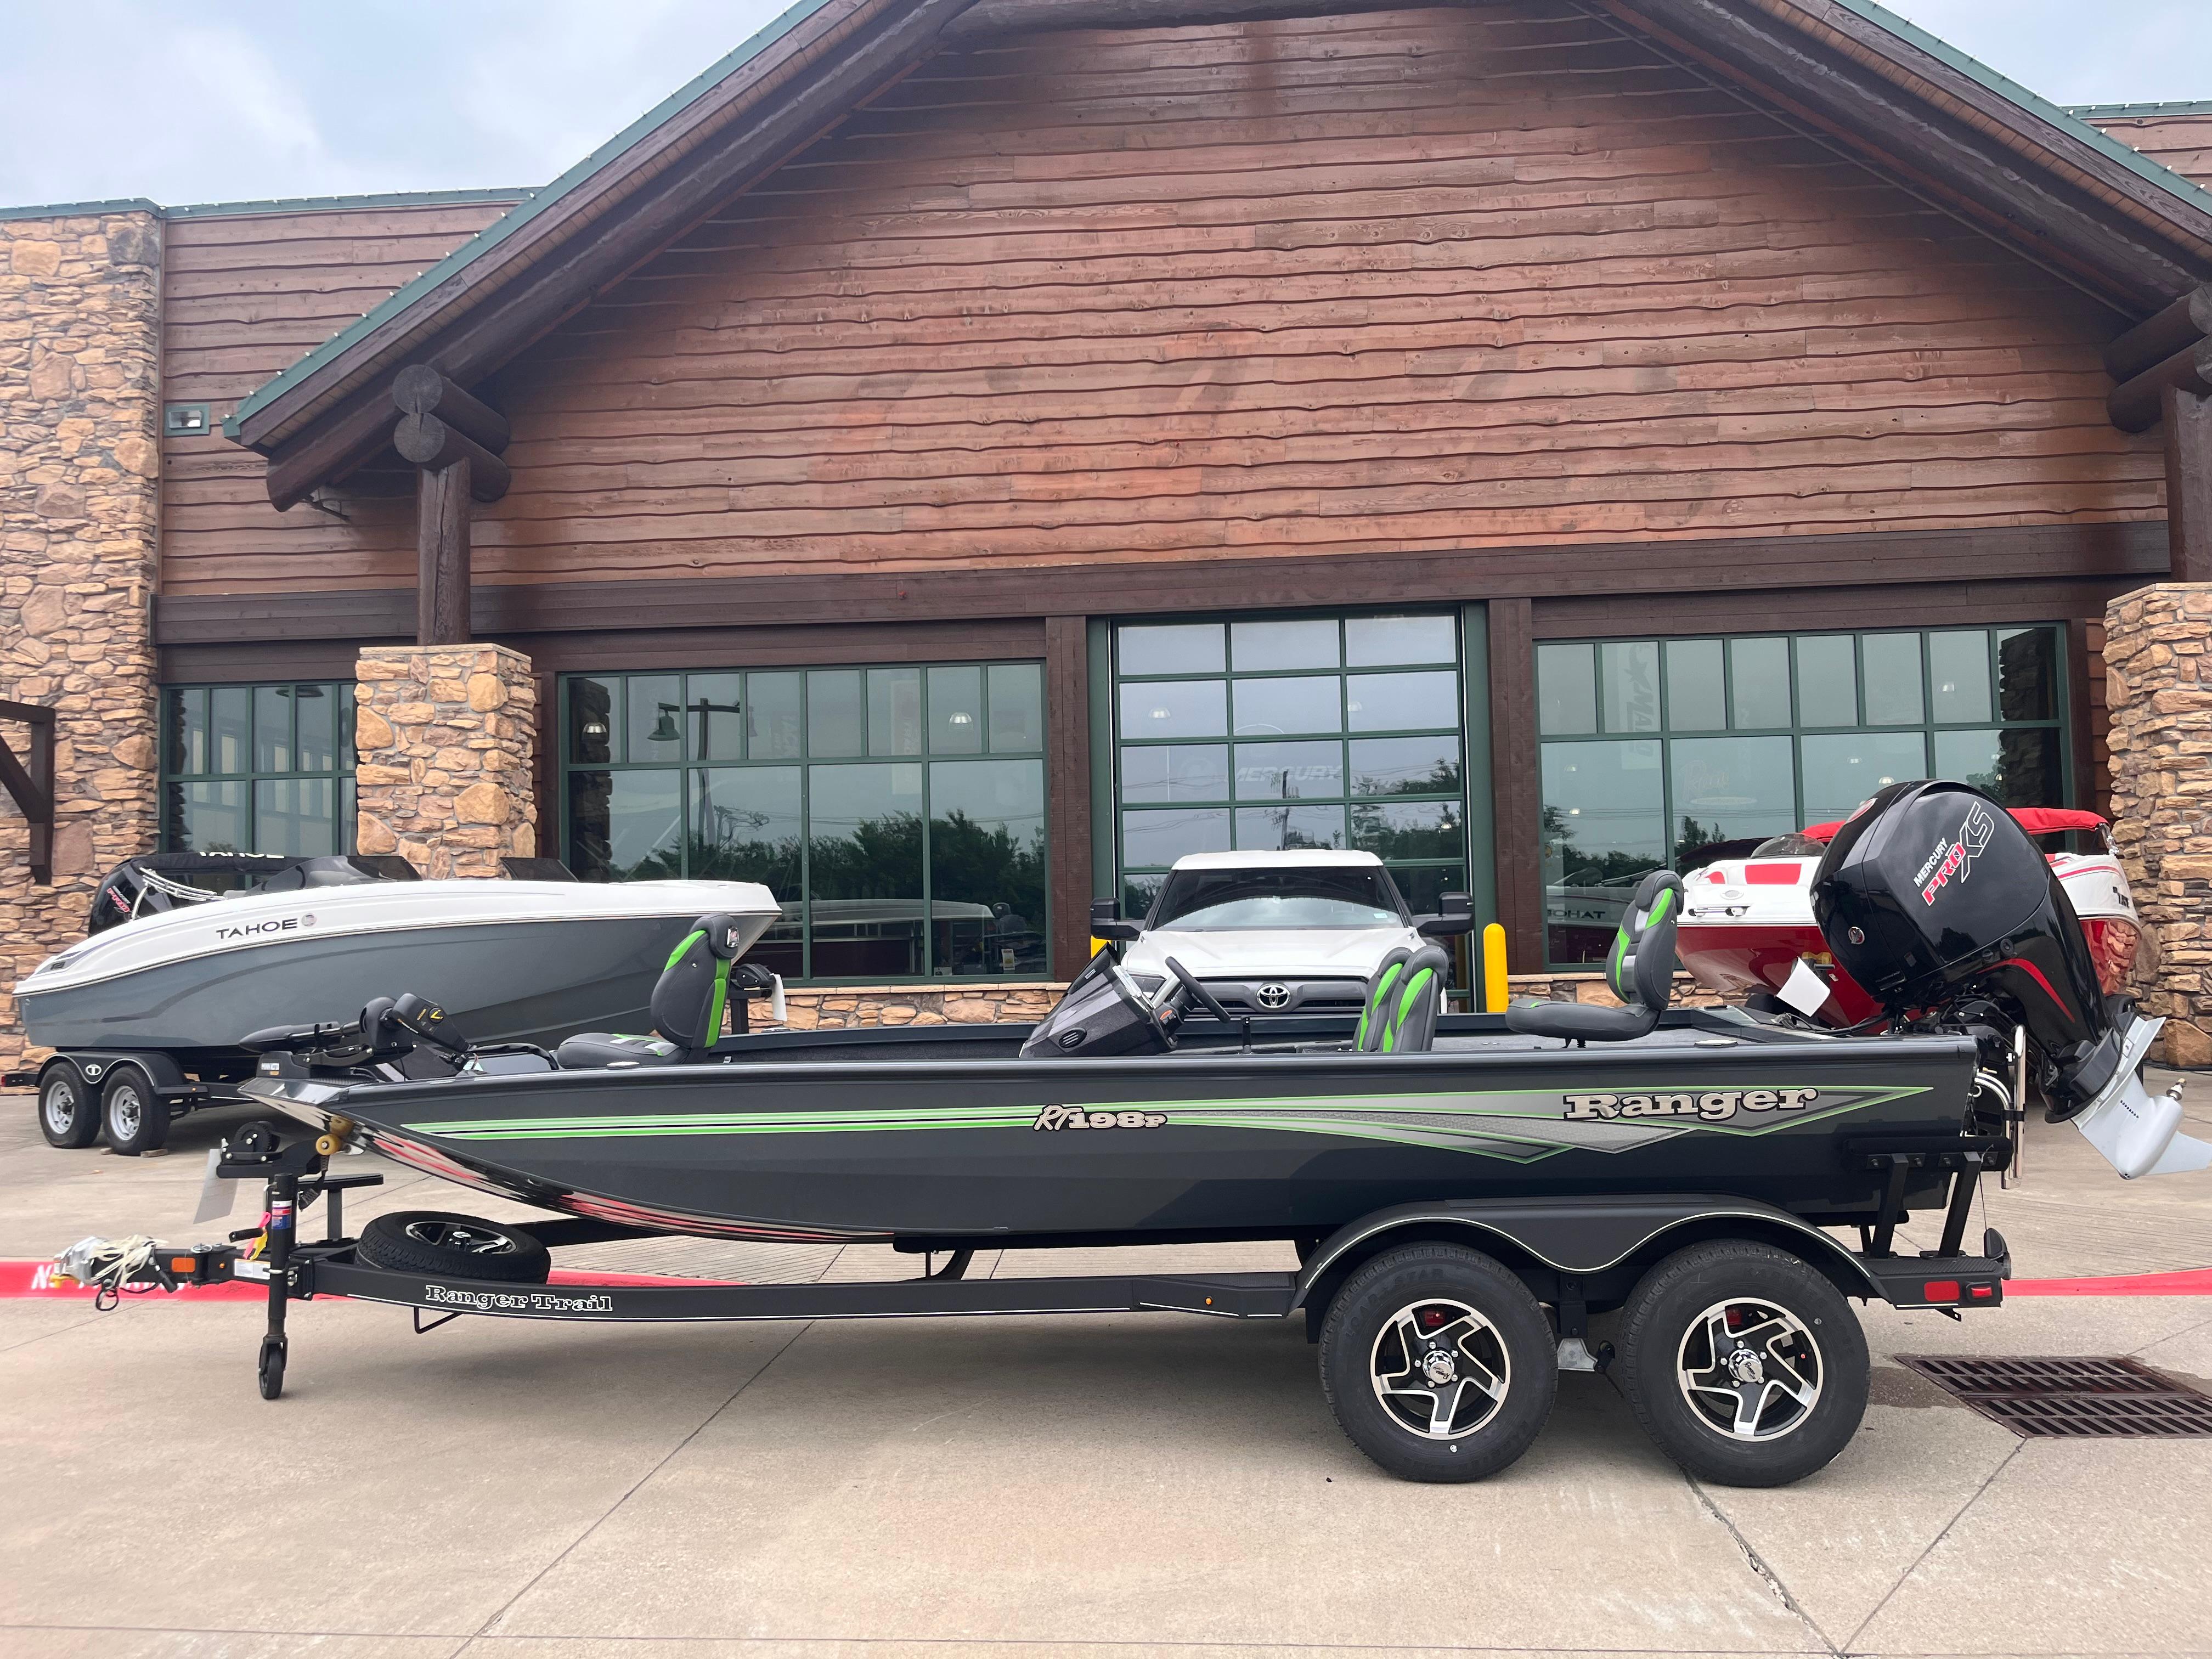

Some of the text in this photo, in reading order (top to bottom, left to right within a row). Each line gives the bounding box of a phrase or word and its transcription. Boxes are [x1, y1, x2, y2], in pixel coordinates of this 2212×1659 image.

[1913, 837, 1948, 888] MERCURY
[1921, 800, 1995, 906] PRO XS
[216, 918, 298, 939] TAHOE
[1564, 1087, 1819, 1120] Ranger
[425, 1284, 613, 1312] Ranger Trail
